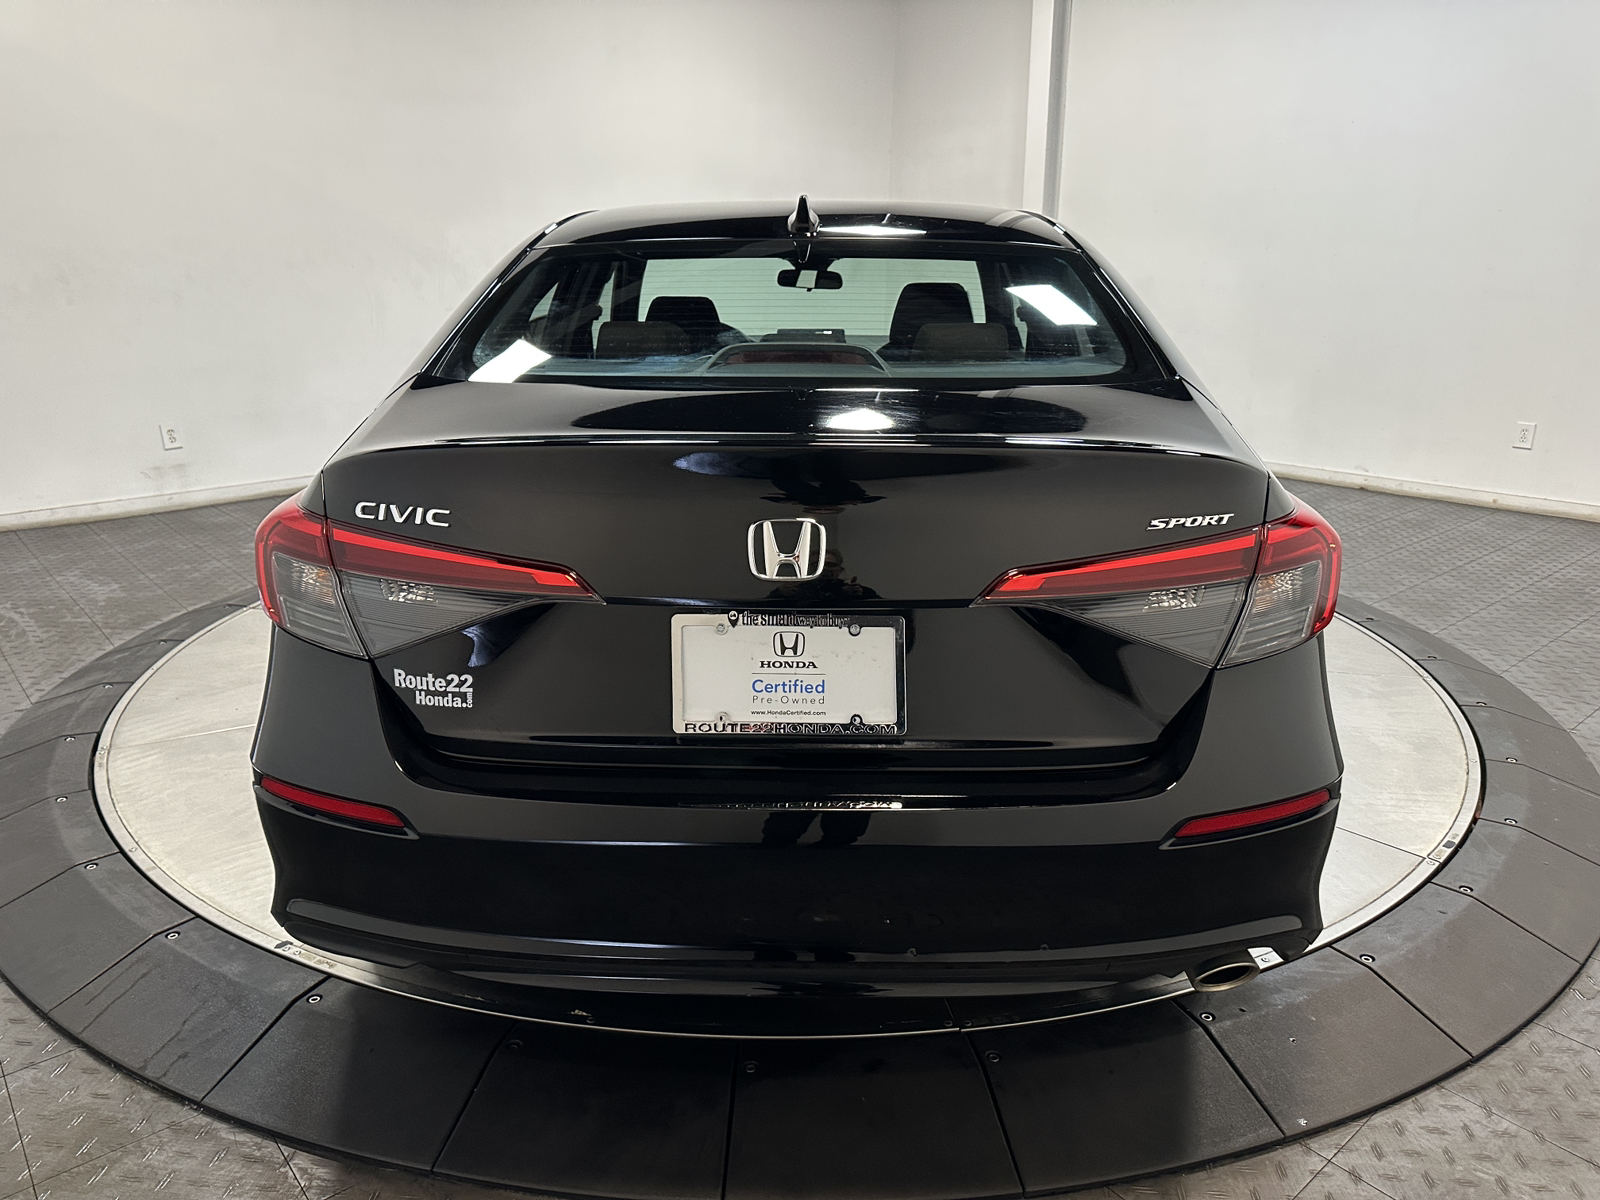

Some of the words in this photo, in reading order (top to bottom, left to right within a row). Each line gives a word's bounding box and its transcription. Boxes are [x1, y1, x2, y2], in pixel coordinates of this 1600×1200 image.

[354, 501, 451, 527] CIVIC
[1146, 513, 1235, 531] SPORT
[741, 611, 759, 627] the
[759, 660, 818, 669] HONDA
[393, 668, 474, 692] Route22
[751, 679, 826, 694] Certified
[752, 695, 825, 705] Pre-Owned
[684, 722, 897, 735] ROUTE22HONDA.COM
